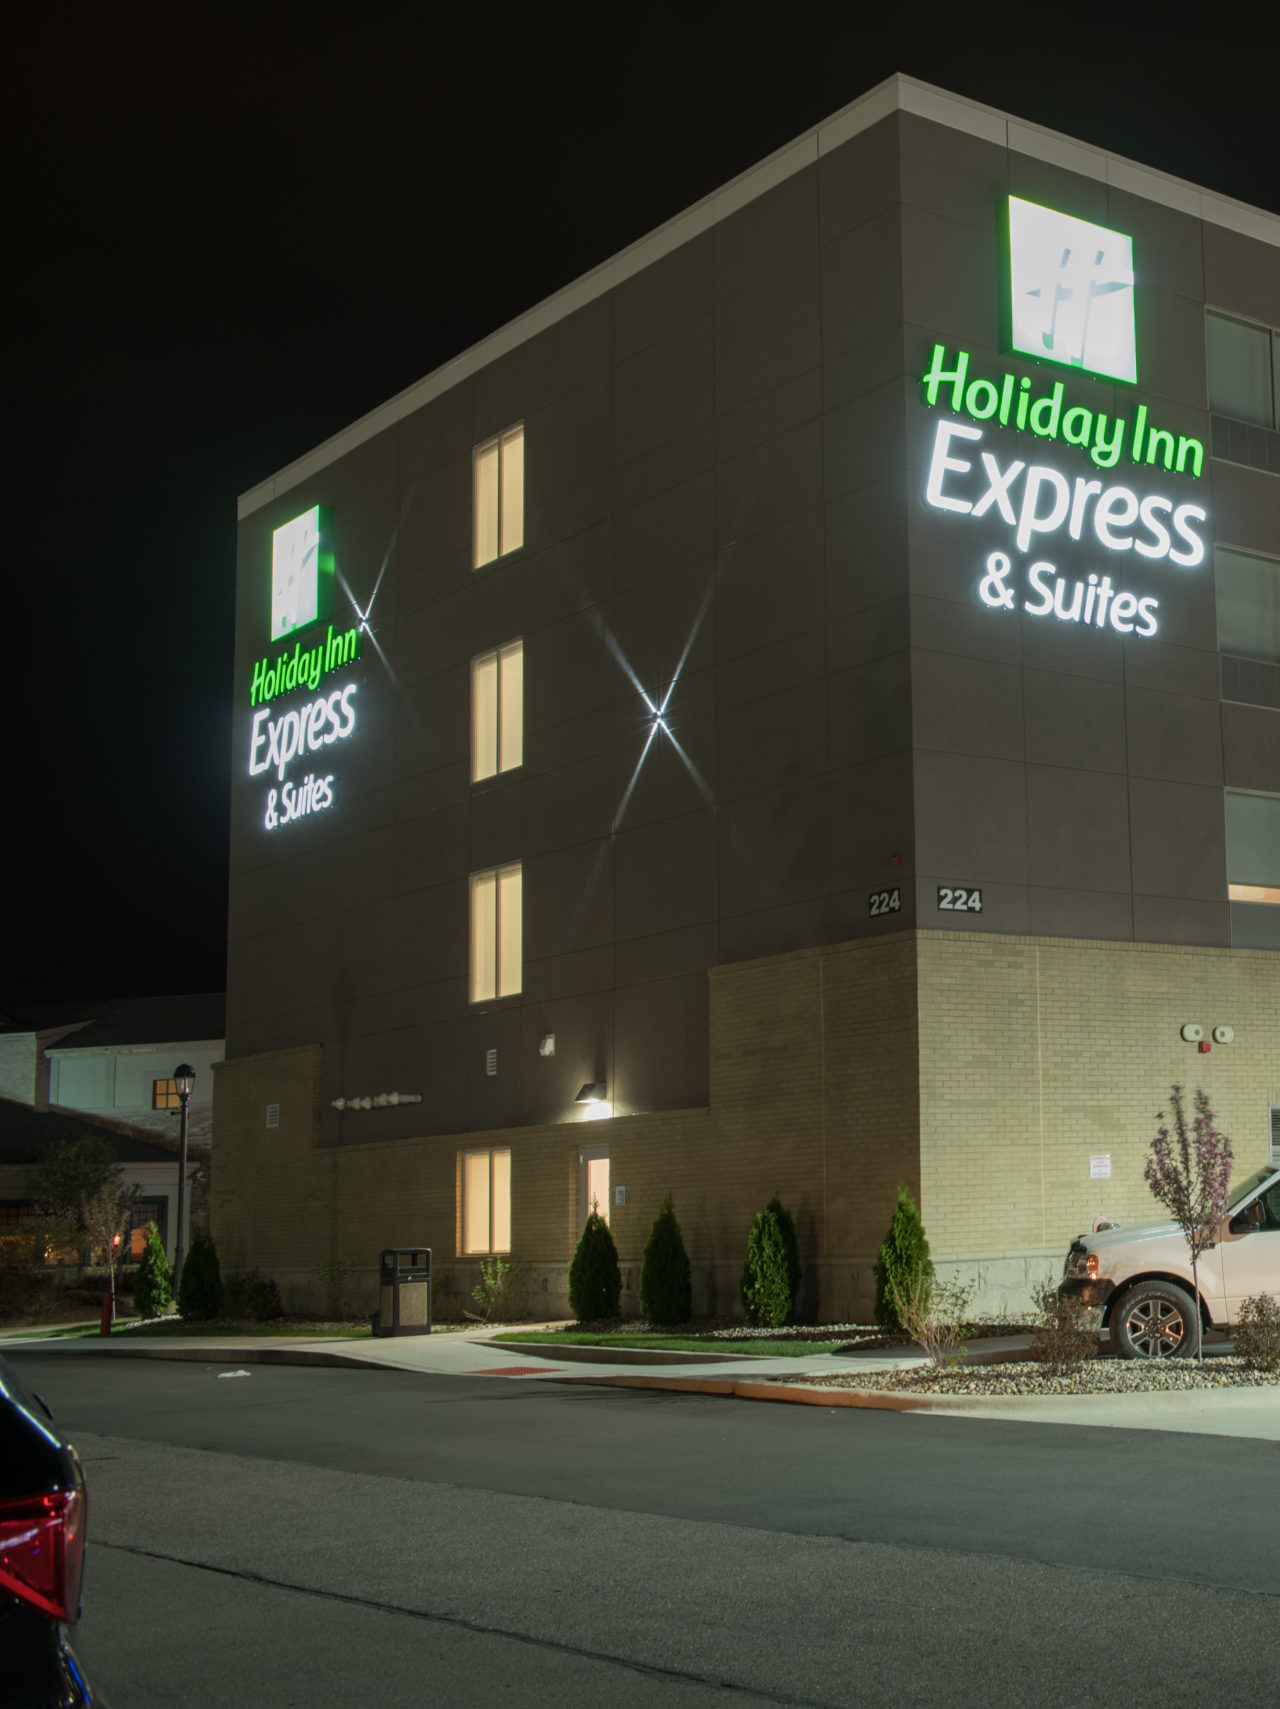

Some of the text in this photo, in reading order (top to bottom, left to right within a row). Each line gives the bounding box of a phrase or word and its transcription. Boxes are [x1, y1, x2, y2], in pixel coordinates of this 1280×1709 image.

[923, 344, 1205, 477] Holiday Inn
[926, 419, 1207, 566] Express
[979, 552, 1160, 637] & Suites
[251, 625, 356, 706] Holiday Inn
[249, 684, 357, 780] Express
[265, 774, 334, 830] & Suites
[870, 890, 900, 916] 224
[939, 889, 982, 912] 224
